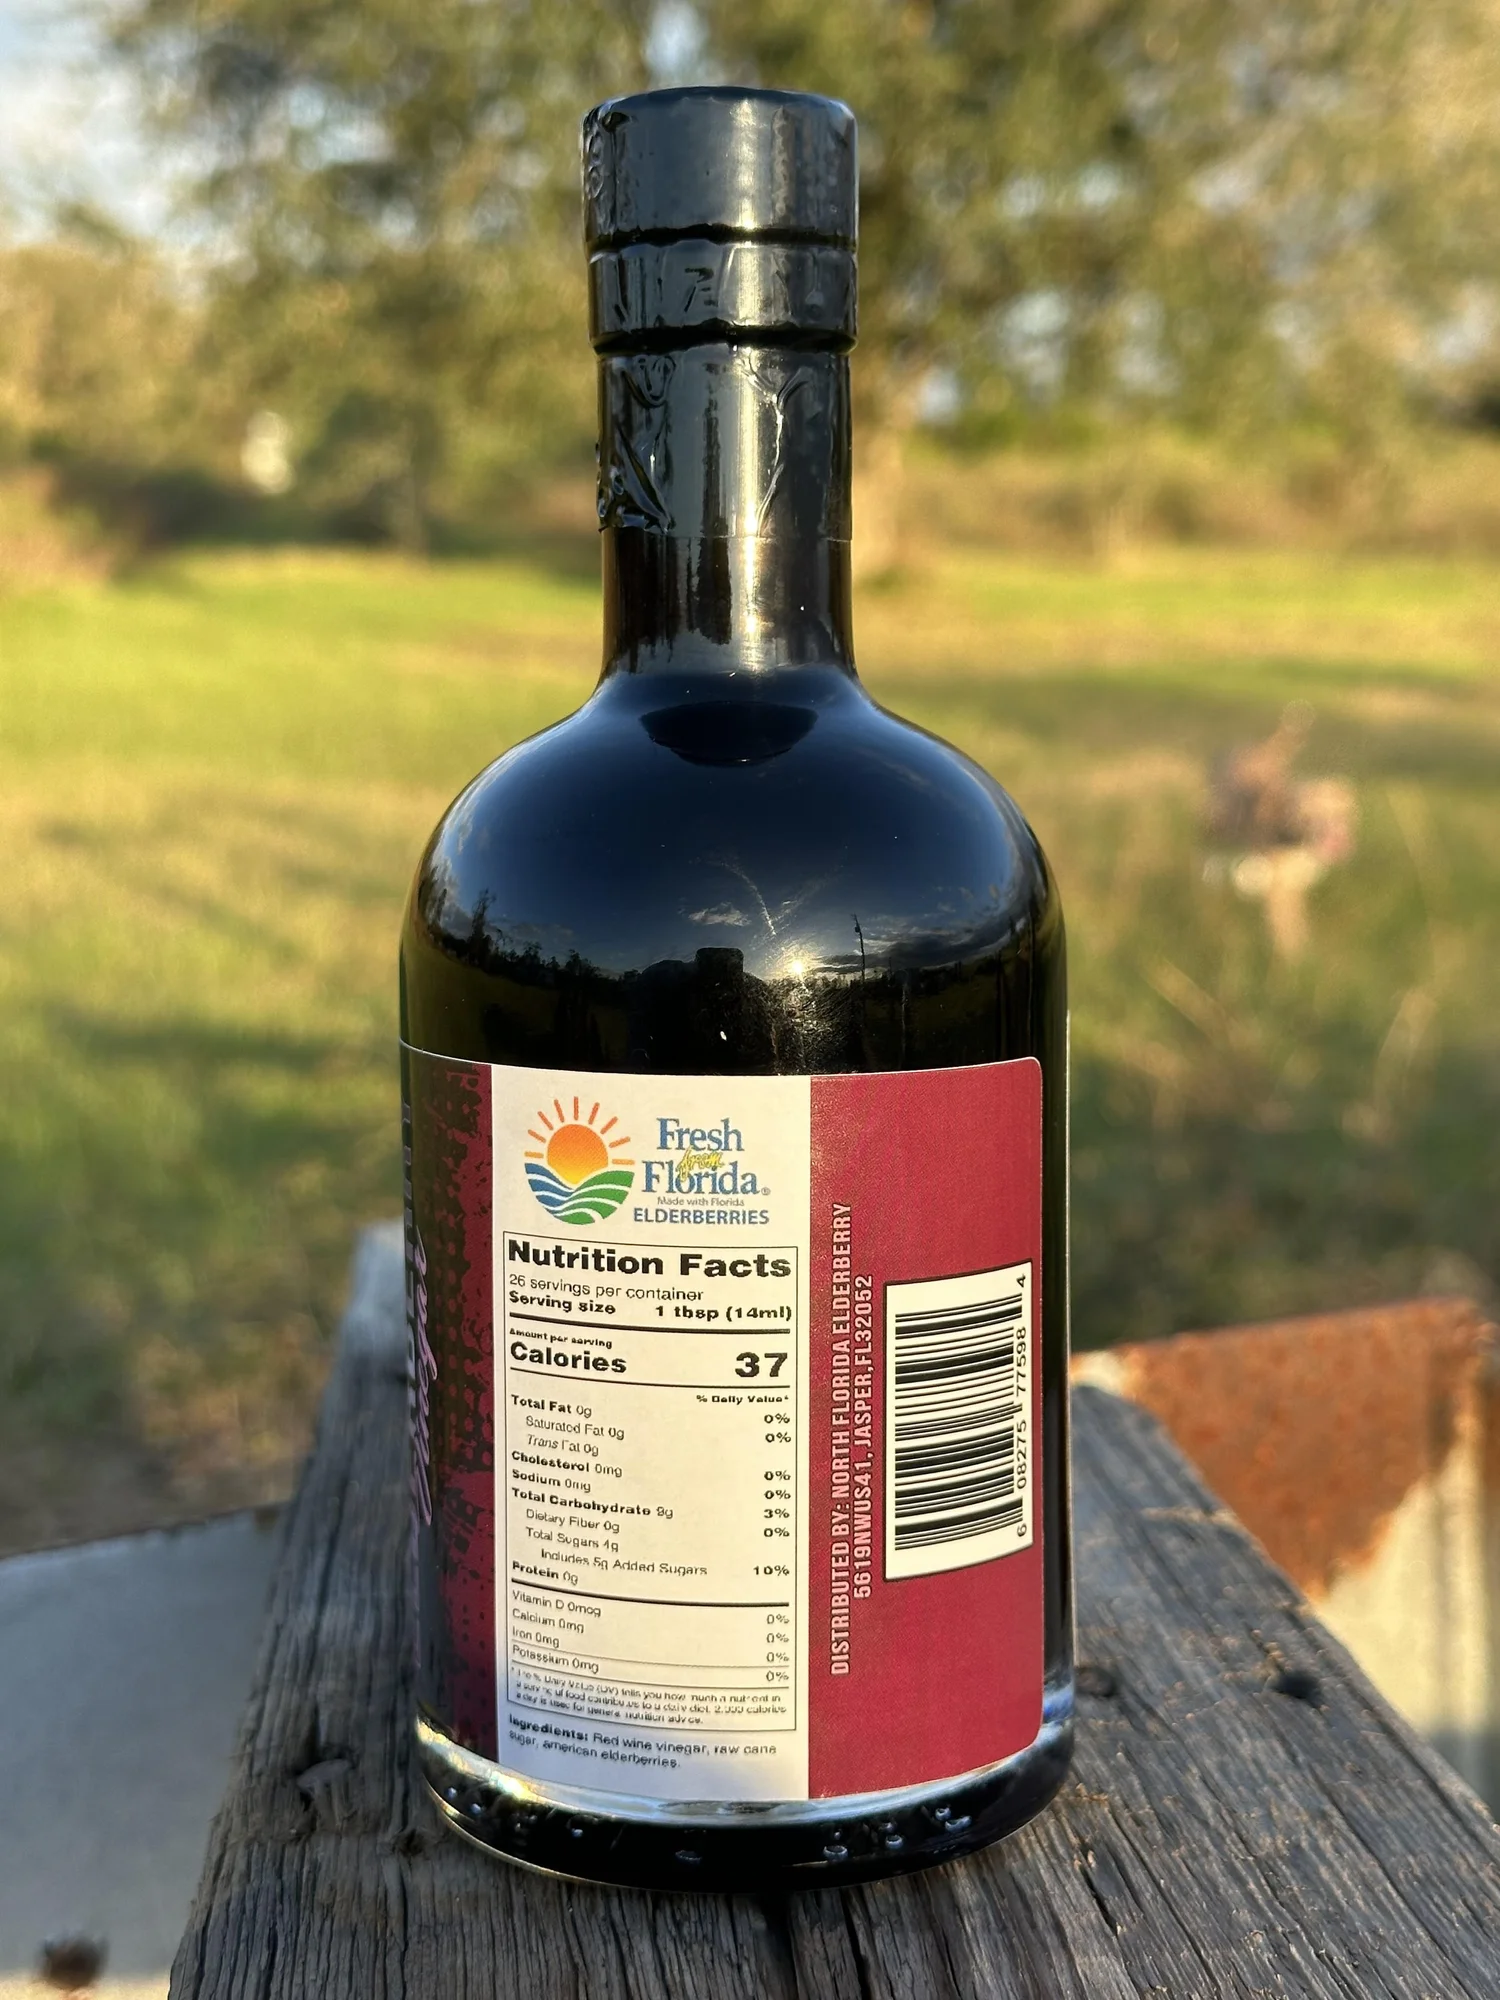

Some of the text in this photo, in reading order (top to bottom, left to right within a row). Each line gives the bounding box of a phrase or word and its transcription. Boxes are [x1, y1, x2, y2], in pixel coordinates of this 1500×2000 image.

[656, 1117, 745, 1152] Fresh
[641, 1160, 760, 1195] Florida
[657, 1196, 745, 1207] Made with Florida
[633, 1207, 770, 1225] ELDERBERRIES
[508, 1239, 792, 1278] Nutrition Facts
[509, 1273, 704, 1301] 26 servings per container
[509, 1290, 616, 1315] Serving size
[655, 1305, 792, 1322] 1 tbsp (14ml)
[509, 1327, 548, 1341] Amount
[510, 1340, 628, 1374] Calories
[735, 1352, 789, 1378] 37
[511, 1394, 593, 1419] Total Fat 0g
[1015, 1273, 1027, 1538] 6 08275 77598 4
[526, 1415, 626, 1441] Saturated Fat 0g
[764, 1413, 791, 1424] 0%
[527, 1434, 559, 1450] Trans
[584, 1443, 600, 1457] 0g
[765, 1431, 792, 1443] 0%
[831, 1202, 851, 1676] DISTRIBUTED BY: NORTH FLORIDA ELDERBERRY
[511, 1450, 623, 1478] Cholesterol 0mg
[764, 1470, 792, 1481] 0%
[512, 1468, 561, 1487] Sodium
[511, 1487, 546, 1503] Total
[549, 1494, 652, 1517] Carbohydrate
[764, 1489, 792, 1500] 0%
[526, 1508, 620, 1534] Dietary Fiber 0g
[763, 1508, 790, 1519] 3%
[526, 1526, 553, 1541] Total
[556, 1532, 600, 1549] Sugars
[763, 1527, 790, 1538] 0%
[512, 1560, 579, 1586] Protein 0g
[540, 1548, 590, 1566] Includes
[612, 1559, 655, 1573] Added
[659, 1562, 708, 1577] Sugars
[753, 1565, 791, 1577] 10%
[512, 1589, 552, 1608] Vitamin
[555, 1599, 565, 1610] D
[512, 1608, 555, 1627] Calcium
[766, 1613, 790, 1625] 0%
[512, 1625, 560, 1649] Iron 0mg
[766, 1632, 790, 1644] 0%
[512, 1644, 600, 1675] Potassium 0mg
[766, 1651, 790, 1663] 0%
[765, 1670, 790, 1682] 0%
[508, 1713, 777, 1756] Ingredients: Red wine vinegar, raw cane
[542, 1740, 598, 1758] american
[600, 1749, 681, 1769] elderberries.
